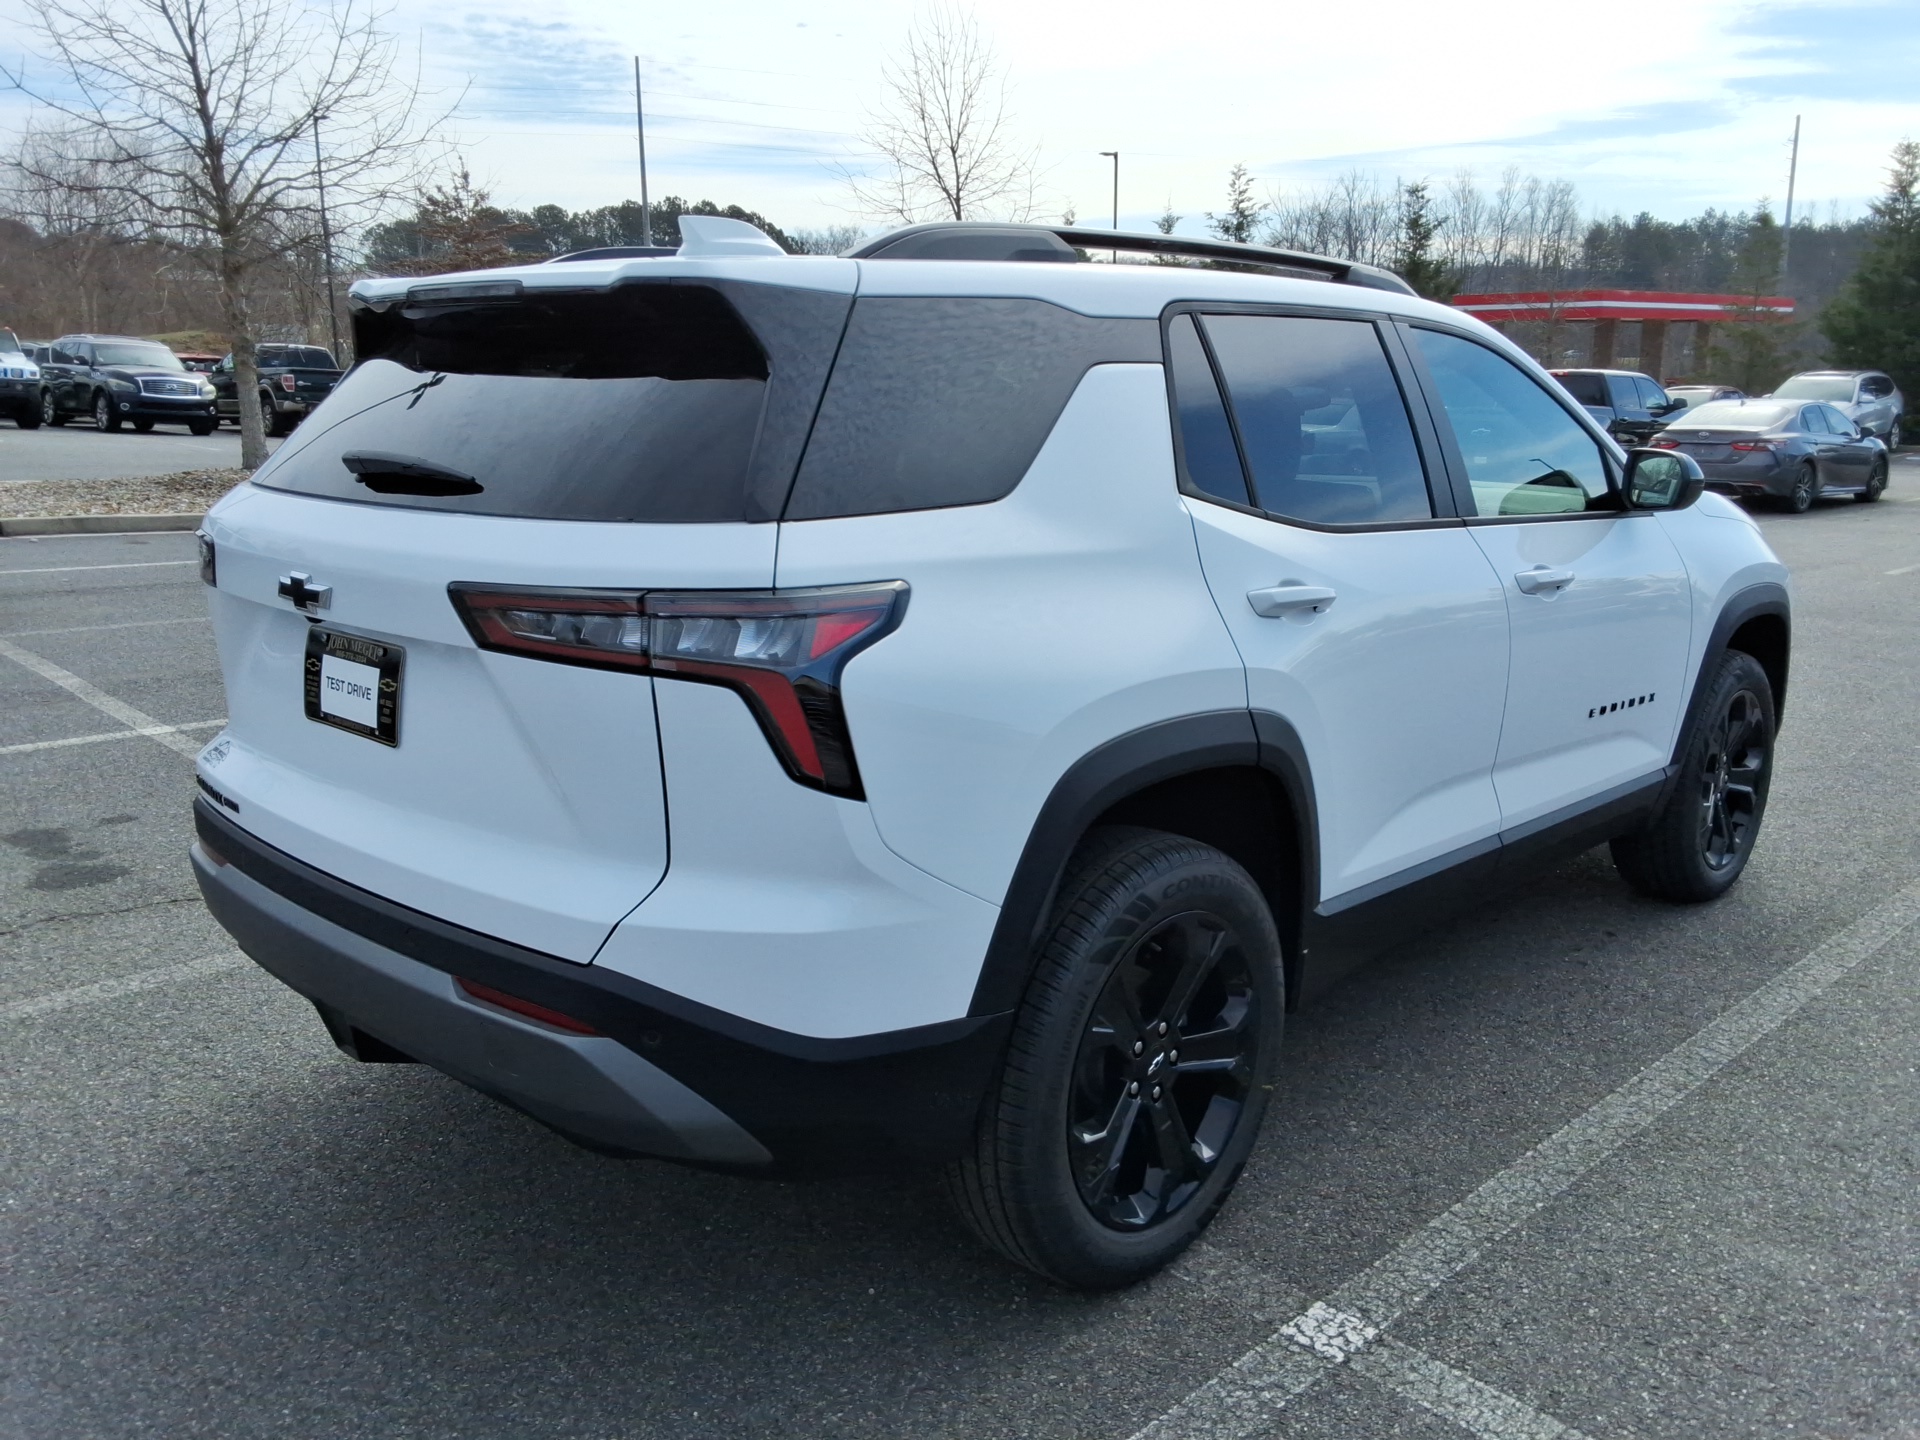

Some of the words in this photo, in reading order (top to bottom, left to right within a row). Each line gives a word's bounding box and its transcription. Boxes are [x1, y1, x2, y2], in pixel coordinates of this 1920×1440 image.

[326, 634, 349, 651] JOHN
[326, 676, 345, 693] TEST
[347, 681, 372, 701] DRIVE
